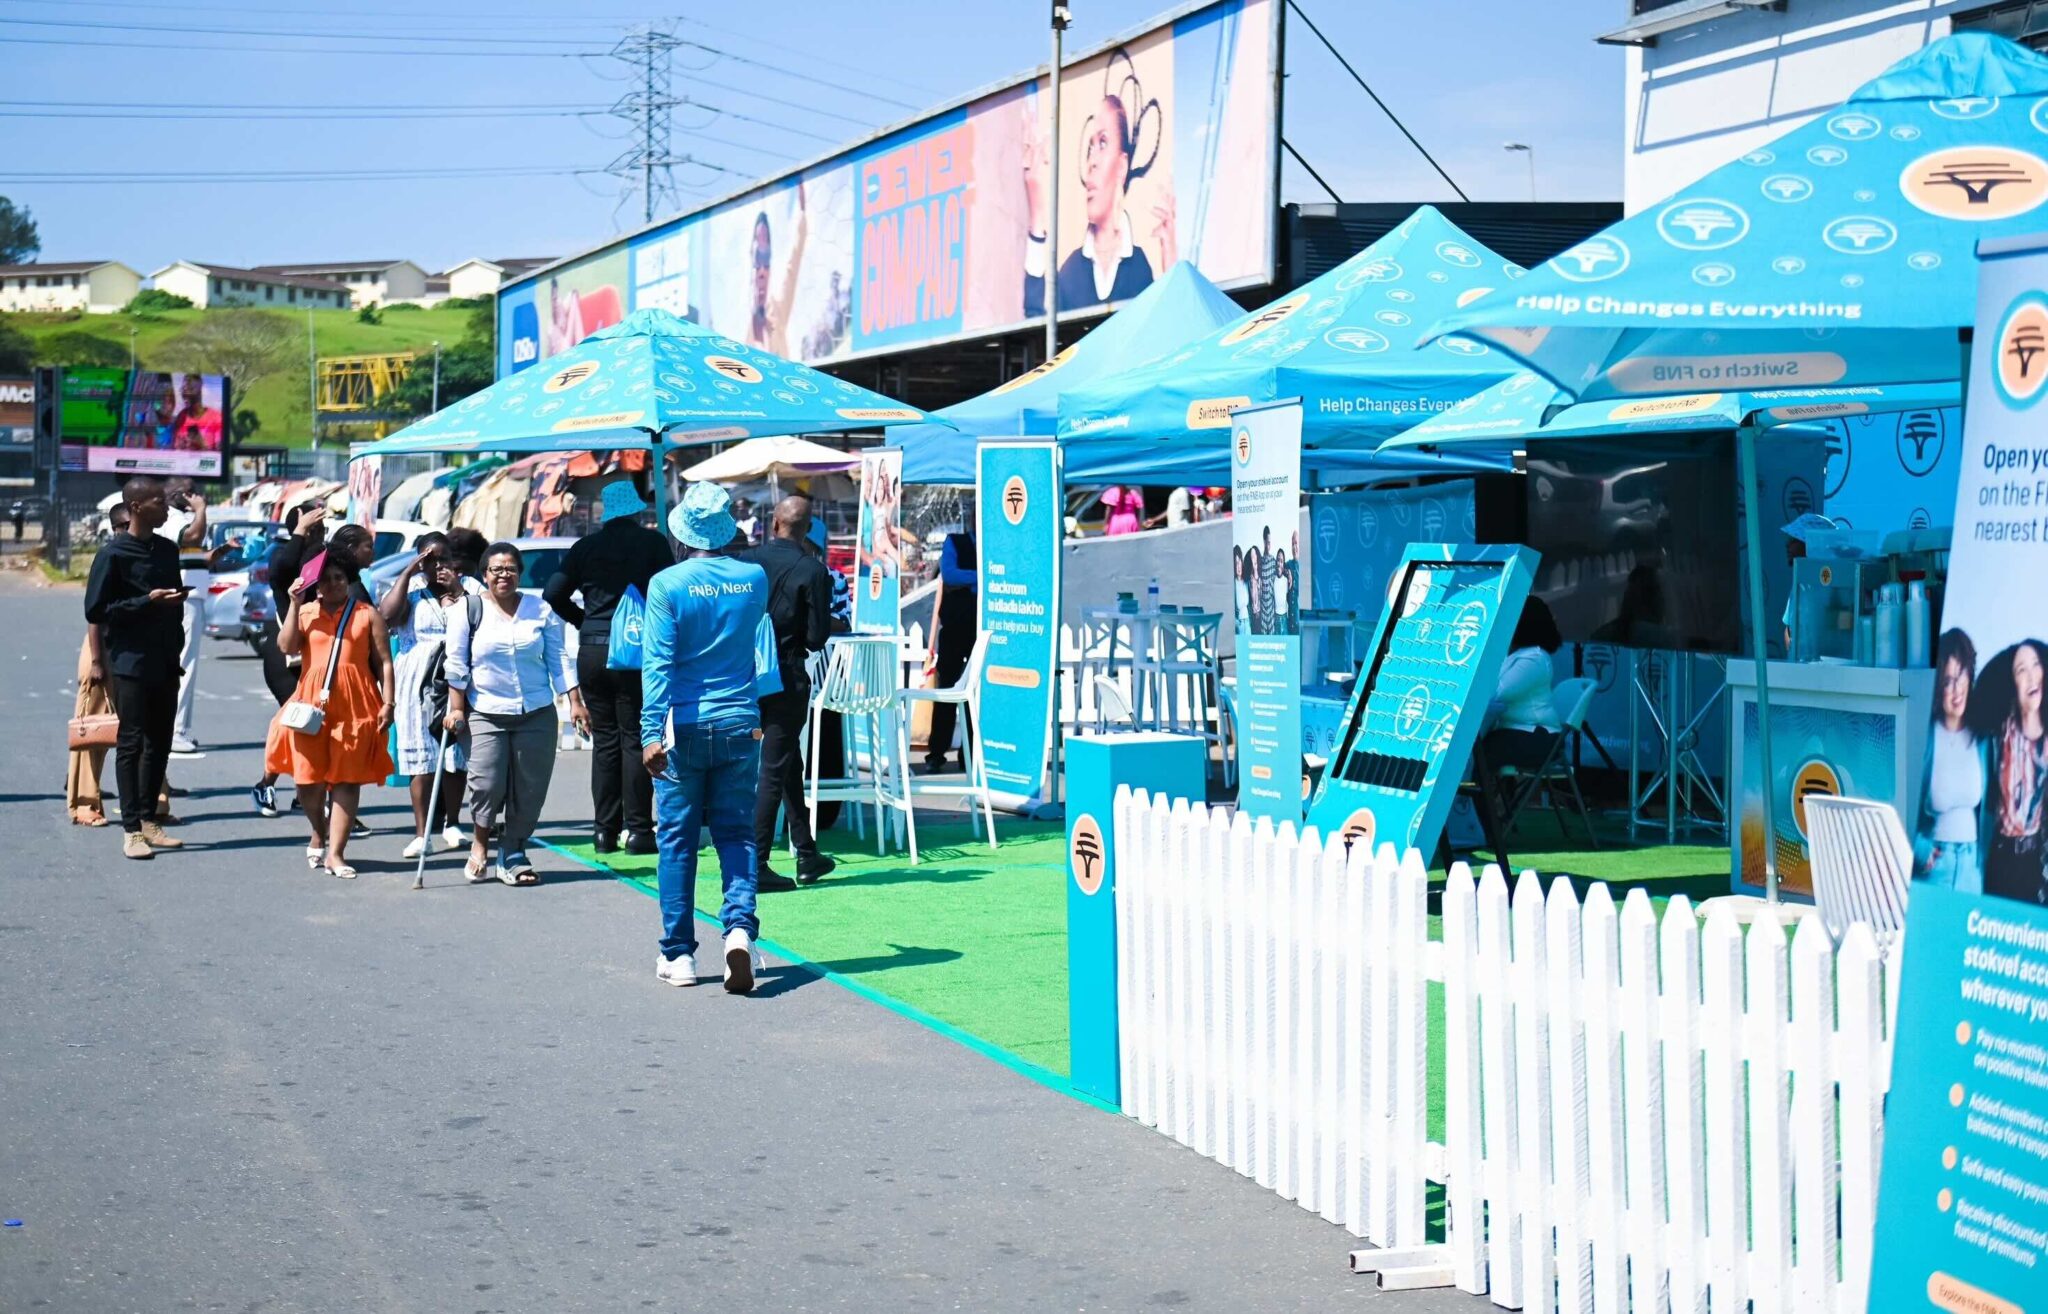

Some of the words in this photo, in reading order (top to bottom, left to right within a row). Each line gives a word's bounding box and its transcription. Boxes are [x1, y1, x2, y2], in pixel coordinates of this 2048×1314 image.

[1516, 294, 1581, 315] Help
[1585, 296, 1704, 318] Changes
[1709, 301, 1862, 319] Everything
[0, 384, 35, 403] Mc
[1320, 398, 1352, 415] Help
[1356, 398, 1417, 414] Changes
[1984, 443, 2028, 474] Open
[1979, 486, 1999, 506] on
[2003, 480, 2031, 506] the
[2034, 480, 2048, 506] F
[1975, 519, 2037, 542] nearest
[688, 584, 720, 599] FNBy
[722, 582, 753, 595] Next
[1029, 622, 1044, 637] buy
[1963, 946, 2021, 979] stokvel
[1961, 977, 2031, 1016] wherever
[1976, 1027, 1995, 1053] Pay
[1994, 1036, 2008, 1054] no
[2007, 1041, 2047, 1072] monthly
[1974, 1052, 1988, 1068] on
[1986, 1058, 2024, 1082] positive
[1969, 1092, 2001, 1118] Added
[1999, 1105, 2044, 1133] members
[2003, 1126, 2020, 1147] for
[1962, 1156, 1985, 1179] Safe
[1983, 1166, 2004, 1187] and
[1957, 1197, 1995, 1228] Receive
[1992, 1213, 2047, 1250] discounted
[1986, 1235, 2037, 1269] premiums
